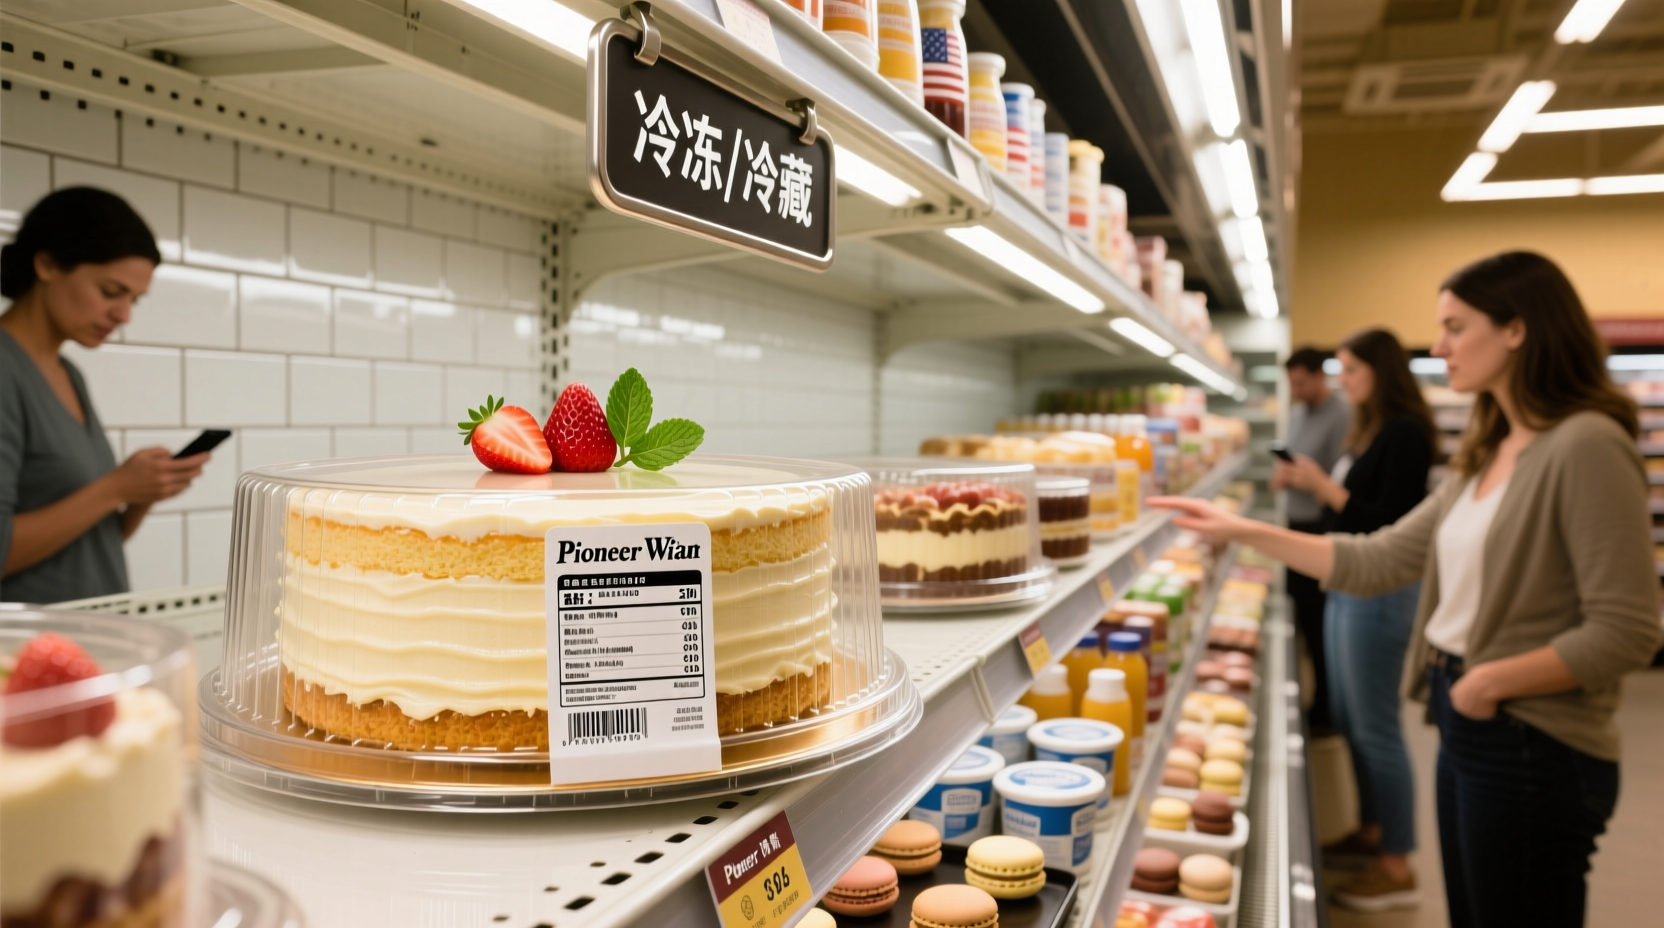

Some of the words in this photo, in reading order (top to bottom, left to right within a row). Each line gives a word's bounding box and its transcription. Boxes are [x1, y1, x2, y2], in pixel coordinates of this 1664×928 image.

[633, 89, 812, 228] 冷冻/冷藏
[556, 540, 643, 564] Pioneer
